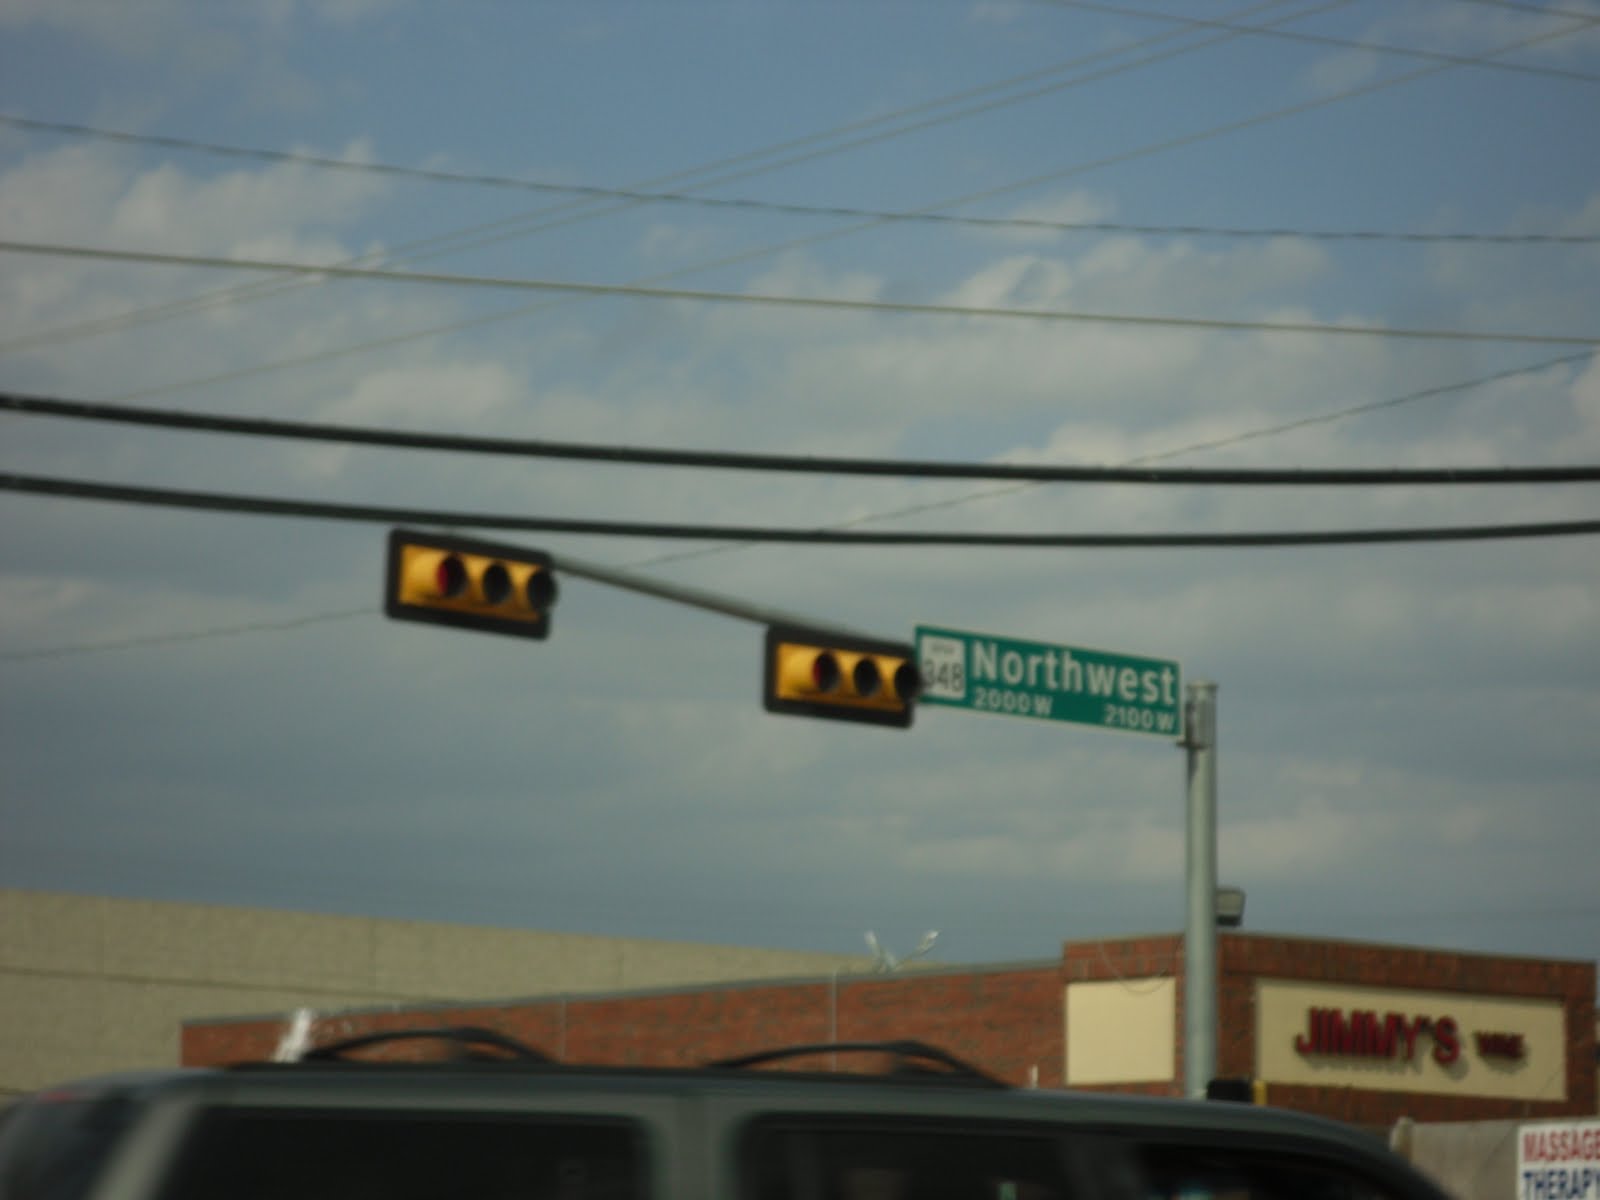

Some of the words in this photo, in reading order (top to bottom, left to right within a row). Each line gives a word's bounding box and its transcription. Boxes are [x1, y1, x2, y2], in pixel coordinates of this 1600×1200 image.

[973, 641, 1176, 705] Northwest
[974, 688, 1029, 714] 2000
[1103, 705, 1154, 730] 2100
[1294, 1006, 1461, 1065] JIMMY'S
